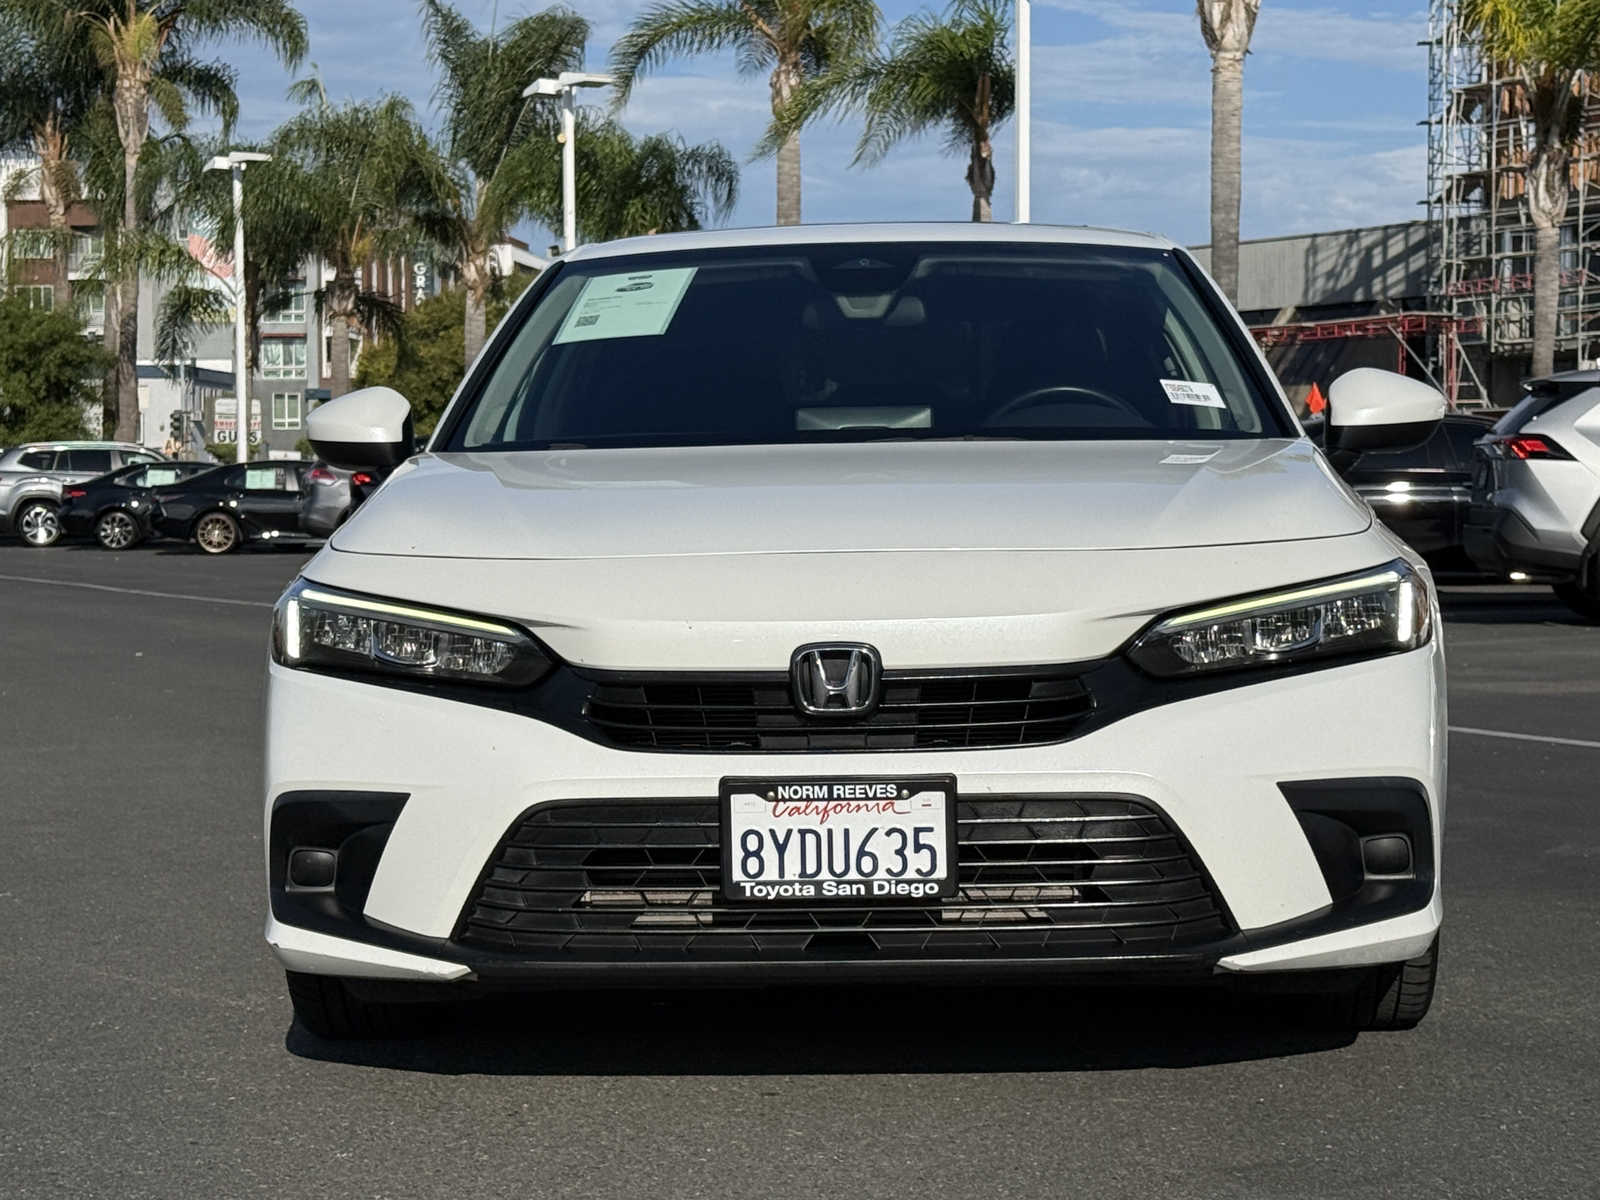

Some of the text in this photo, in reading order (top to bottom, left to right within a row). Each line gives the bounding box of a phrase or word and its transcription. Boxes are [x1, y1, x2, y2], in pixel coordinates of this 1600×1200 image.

[217, 430, 257, 443] GUS
[777, 784, 898, 799] NORM REEVES
[771, 800, 911, 825] California
[740, 827, 938, 879] 8YDU635
[740, 880, 939, 899] Toyota San Diego
